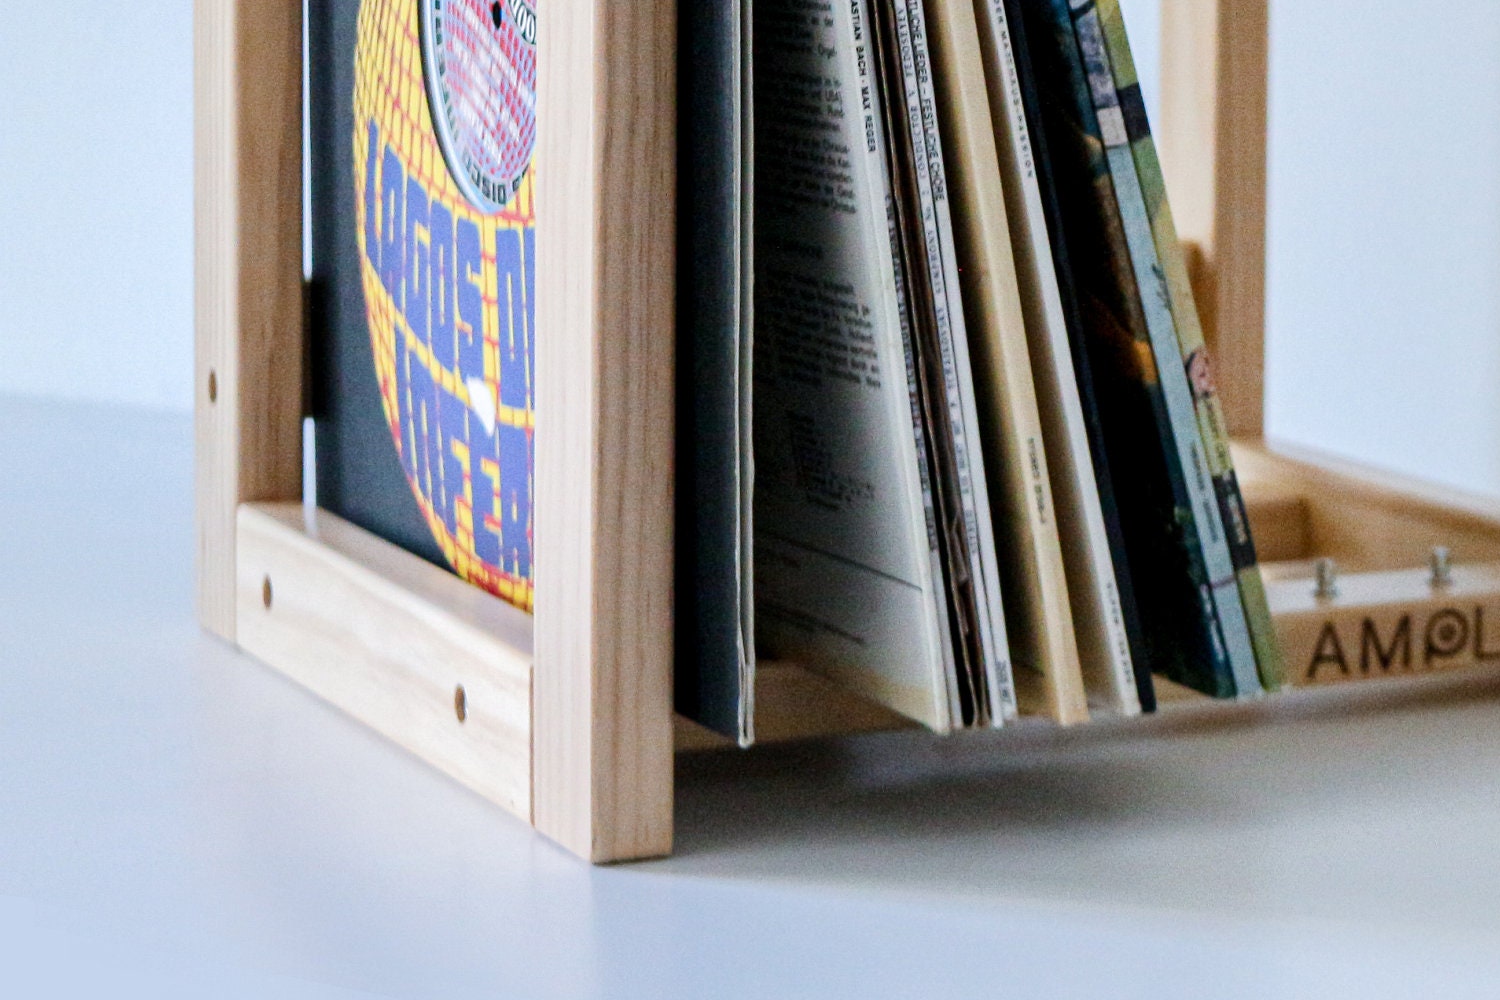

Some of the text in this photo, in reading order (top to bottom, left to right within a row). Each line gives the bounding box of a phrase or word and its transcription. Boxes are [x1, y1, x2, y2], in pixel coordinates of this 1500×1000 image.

[856, 45, 866, 75] BACH
[915, 43, 928, 84] LIEDER
[861, 85, 871, 109] MAX
[865, 114, 876, 152] REGER
[911, 105, 926, 180] CONDUCTOR
[365, 118, 484, 379] LAGOS
